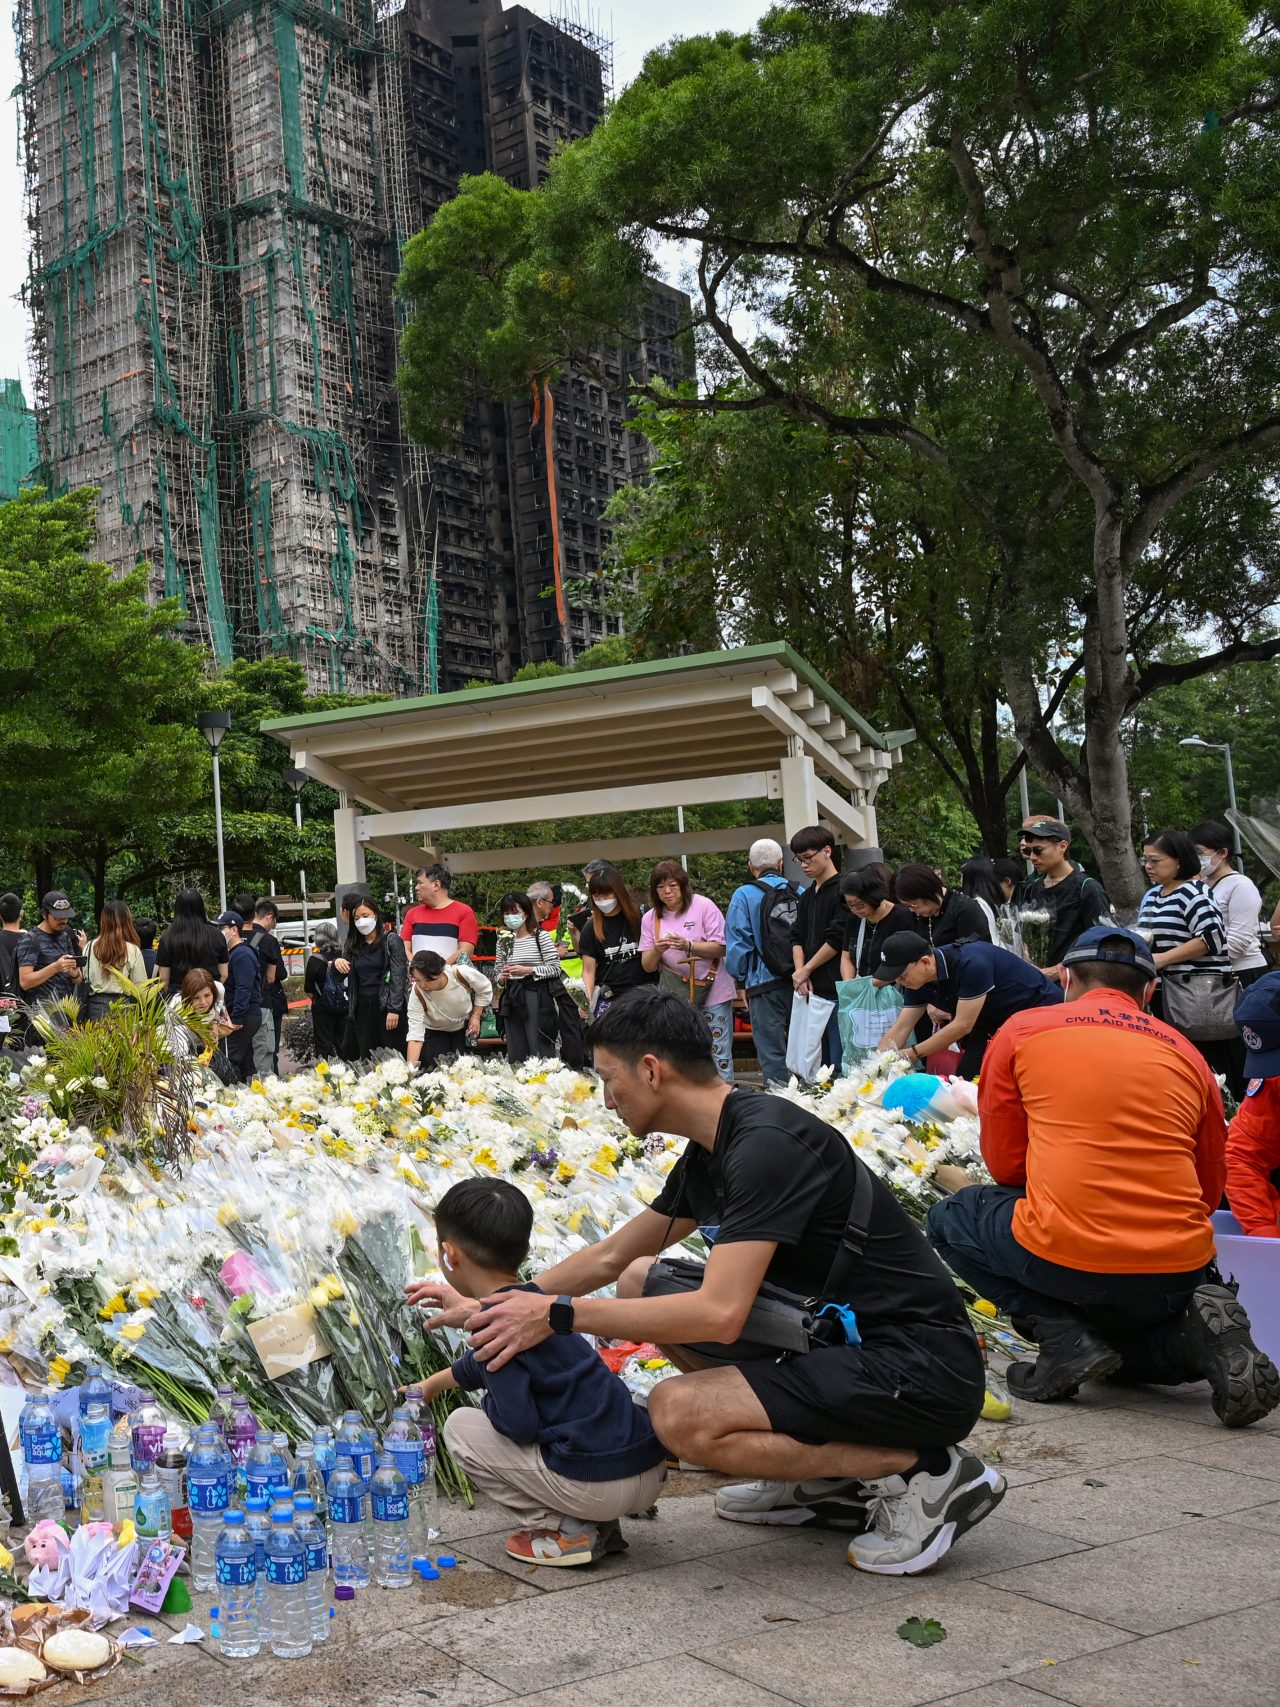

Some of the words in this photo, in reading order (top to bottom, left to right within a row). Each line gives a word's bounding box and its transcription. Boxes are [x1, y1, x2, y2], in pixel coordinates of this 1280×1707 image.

[1098, 1008, 1151, 1026] 民安隊
[1065, 1016, 1099, 1024] CIVIL
[1102, 1018, 1124, 1026] AID
[1127, 1023, 1177, 1046] SERVICE
[31, 1442, 47, 1450] bon
